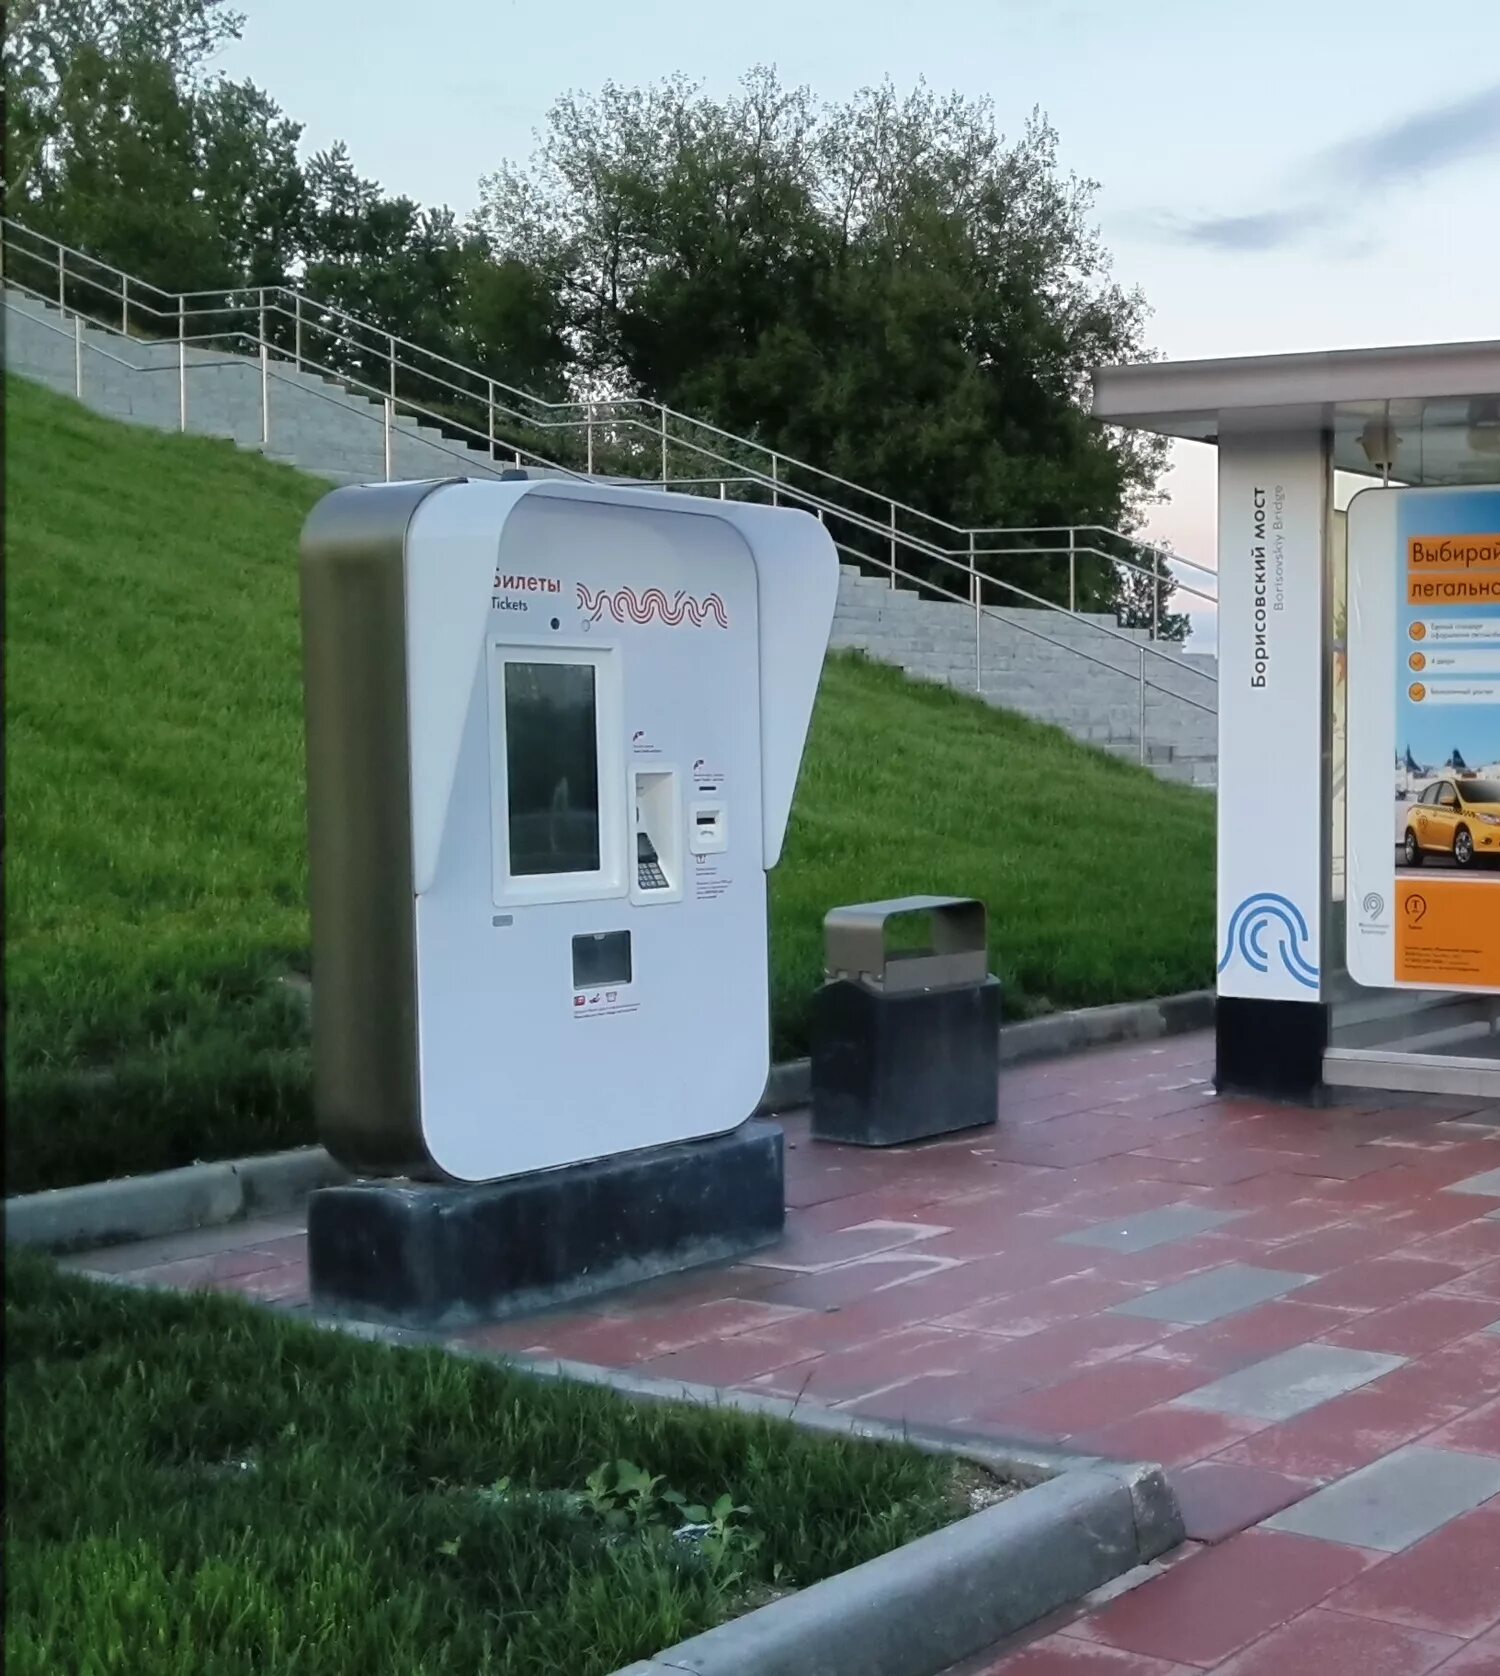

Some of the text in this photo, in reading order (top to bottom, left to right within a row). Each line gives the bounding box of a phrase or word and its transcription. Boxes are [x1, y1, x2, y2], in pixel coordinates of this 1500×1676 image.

[1273, 485, 1285, 529] Bridge
[492, 596, 528, 611] Tickets
[1251, 488, 1269, 688] Борисовский мост
